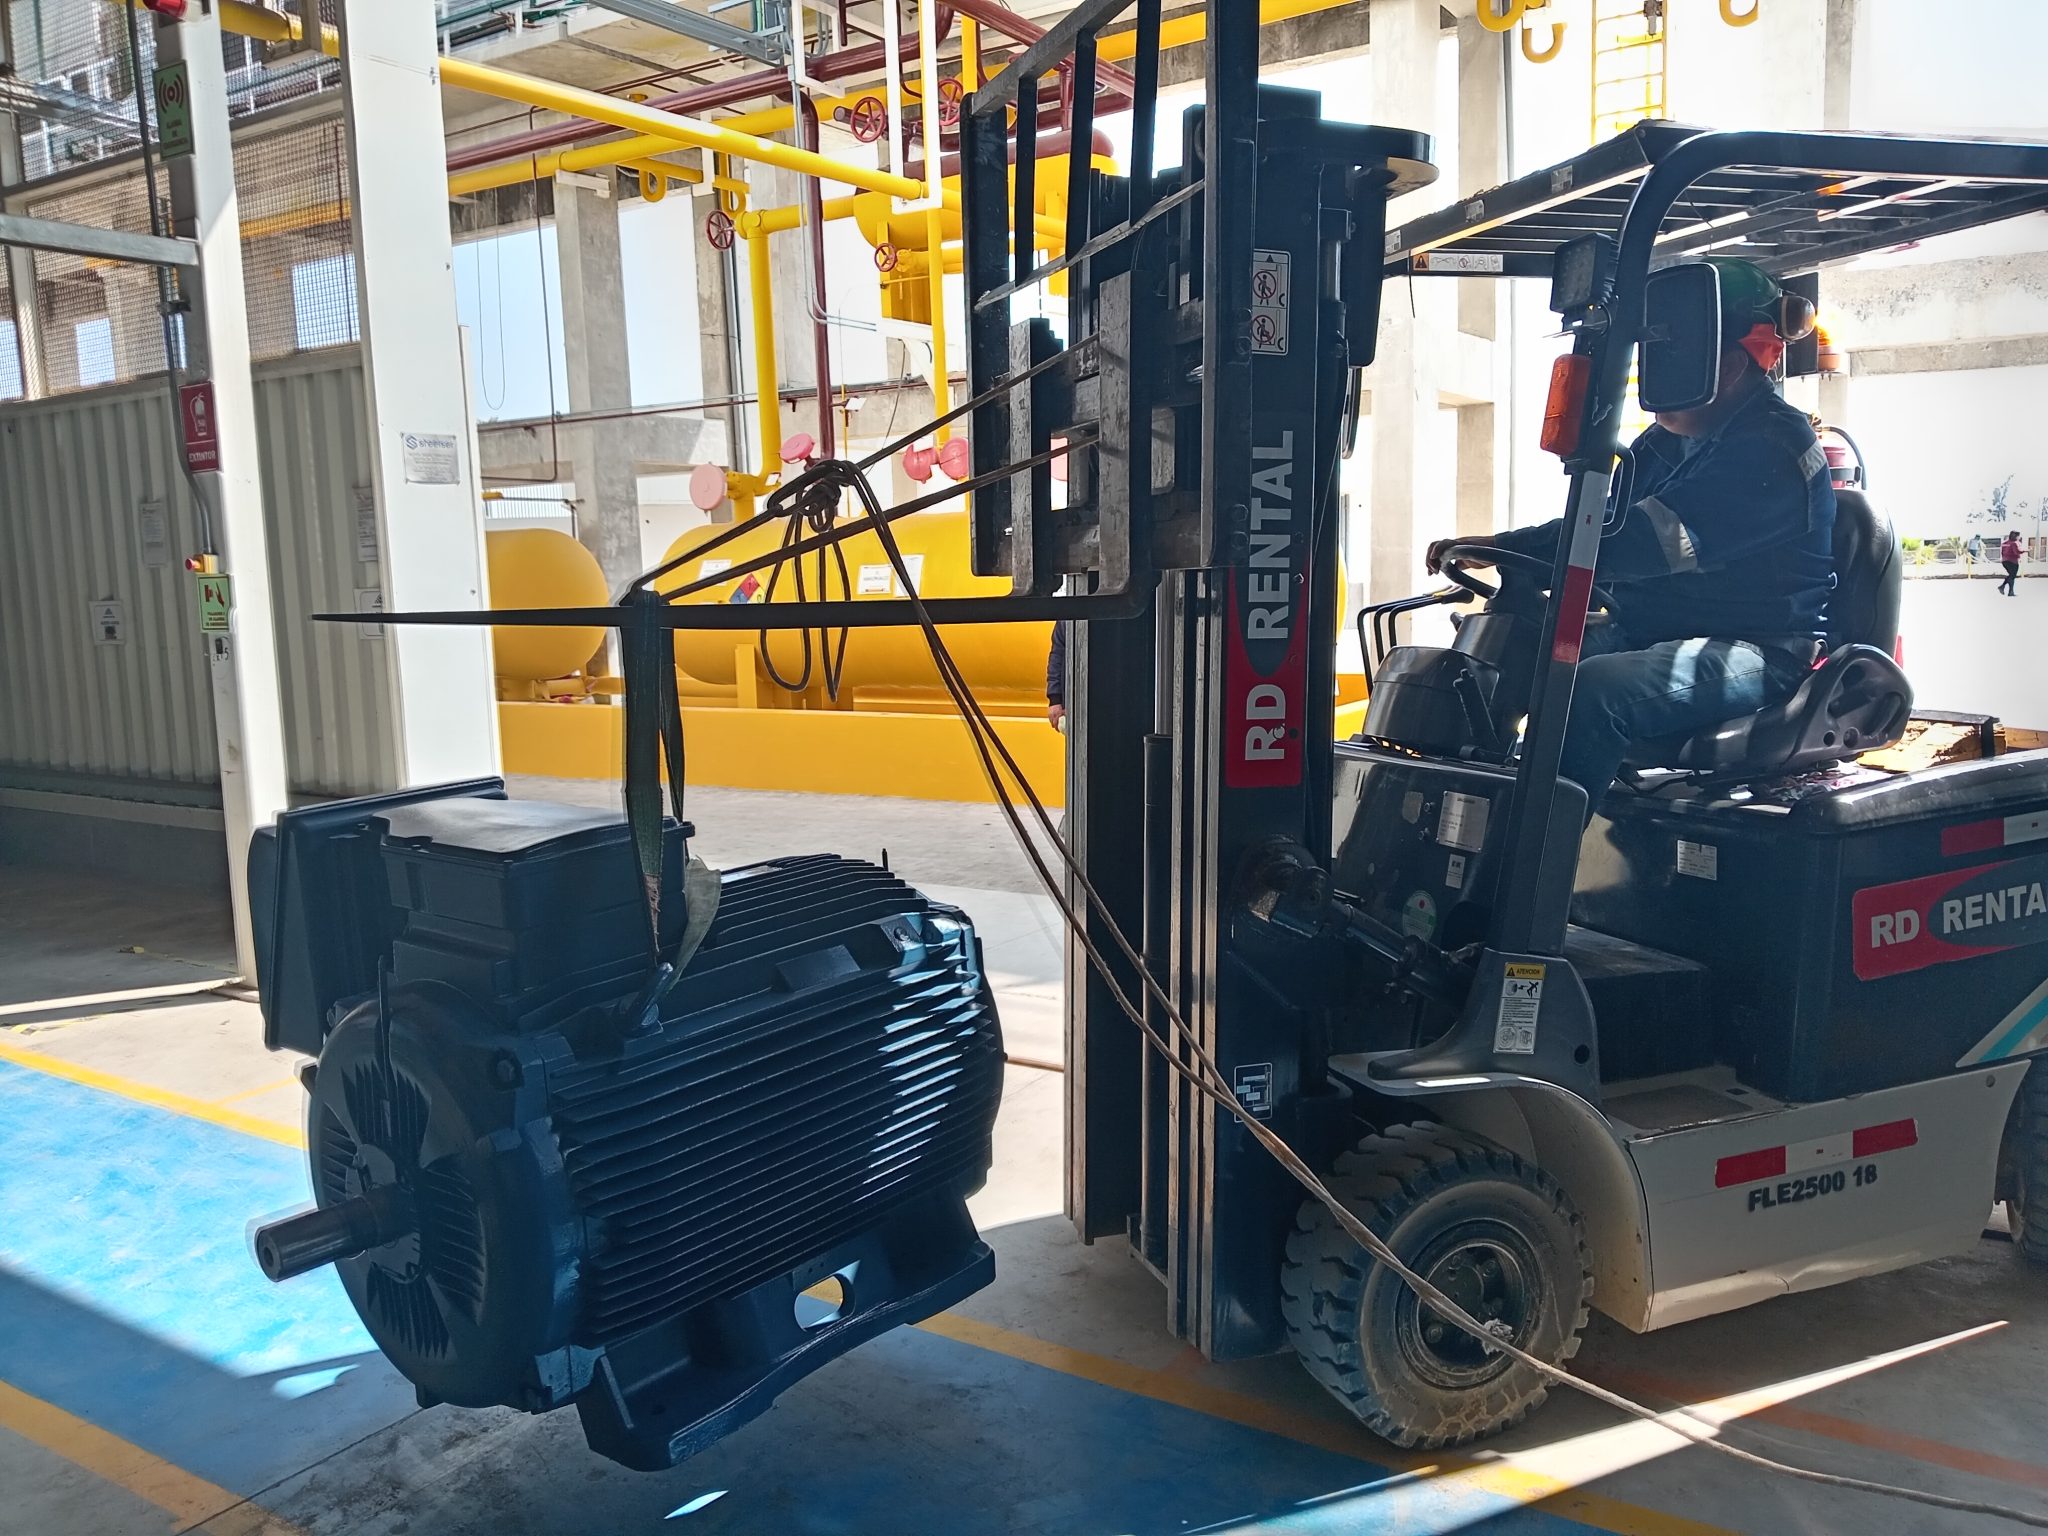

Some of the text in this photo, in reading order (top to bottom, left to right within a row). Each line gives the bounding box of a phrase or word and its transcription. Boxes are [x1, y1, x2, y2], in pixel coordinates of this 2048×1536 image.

[188, 450, 216, 463] EXTINTOR
[1244, 430, 1294, 761] RD RENTAL
[1871, 883, 2047, 948] RD RENTA
[1748, 1164, 1878, 1213] FLE2500 18
